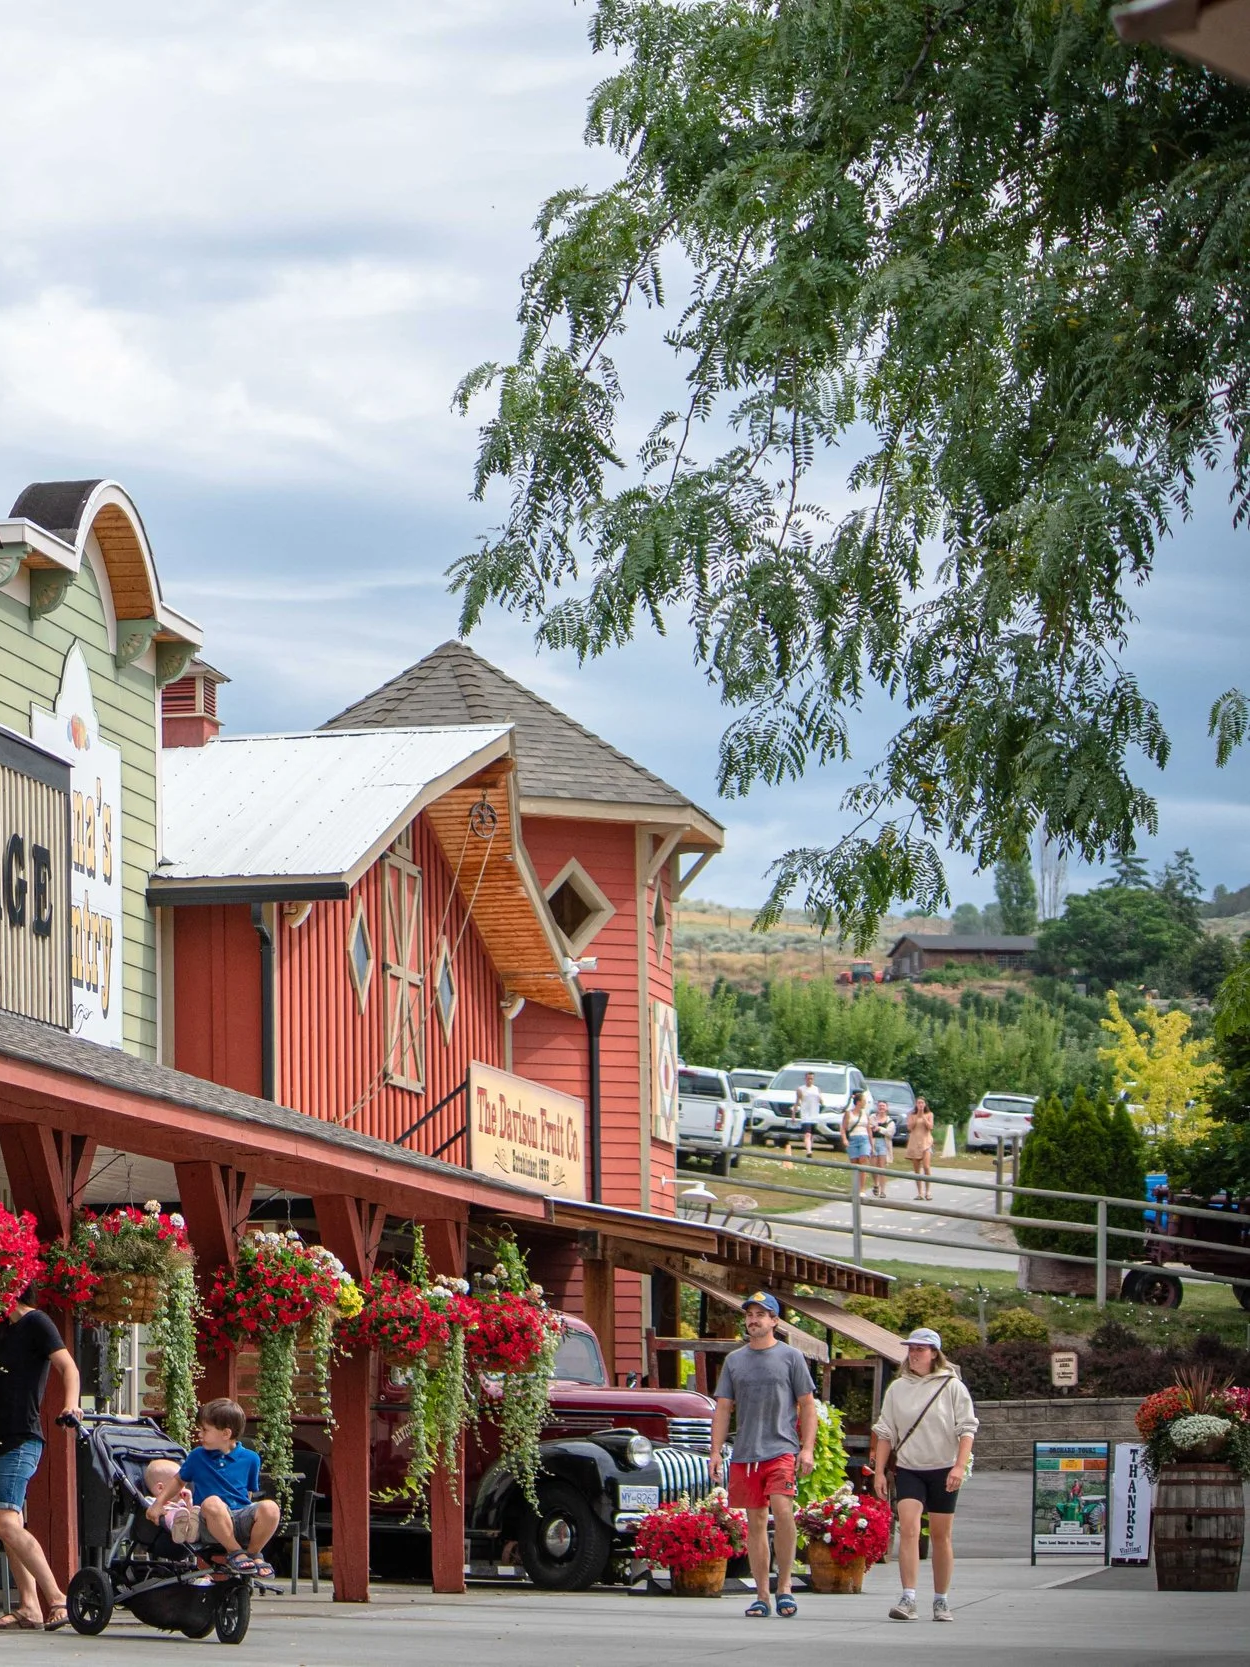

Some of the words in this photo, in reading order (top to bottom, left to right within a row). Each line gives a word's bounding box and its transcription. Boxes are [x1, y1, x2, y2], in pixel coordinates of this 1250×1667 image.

[71, 776, 113, 888] na's
[71, 889, 113, 1020] ntry
[477, 1086, 497, 1137] The
[498, 1093, 539, 1150] Davison
[540, 1107, 564, 1159] Fruit
[566, 1116, 581, 1163] Co.
[1126, 1449, 1139, 1539] THANKS
